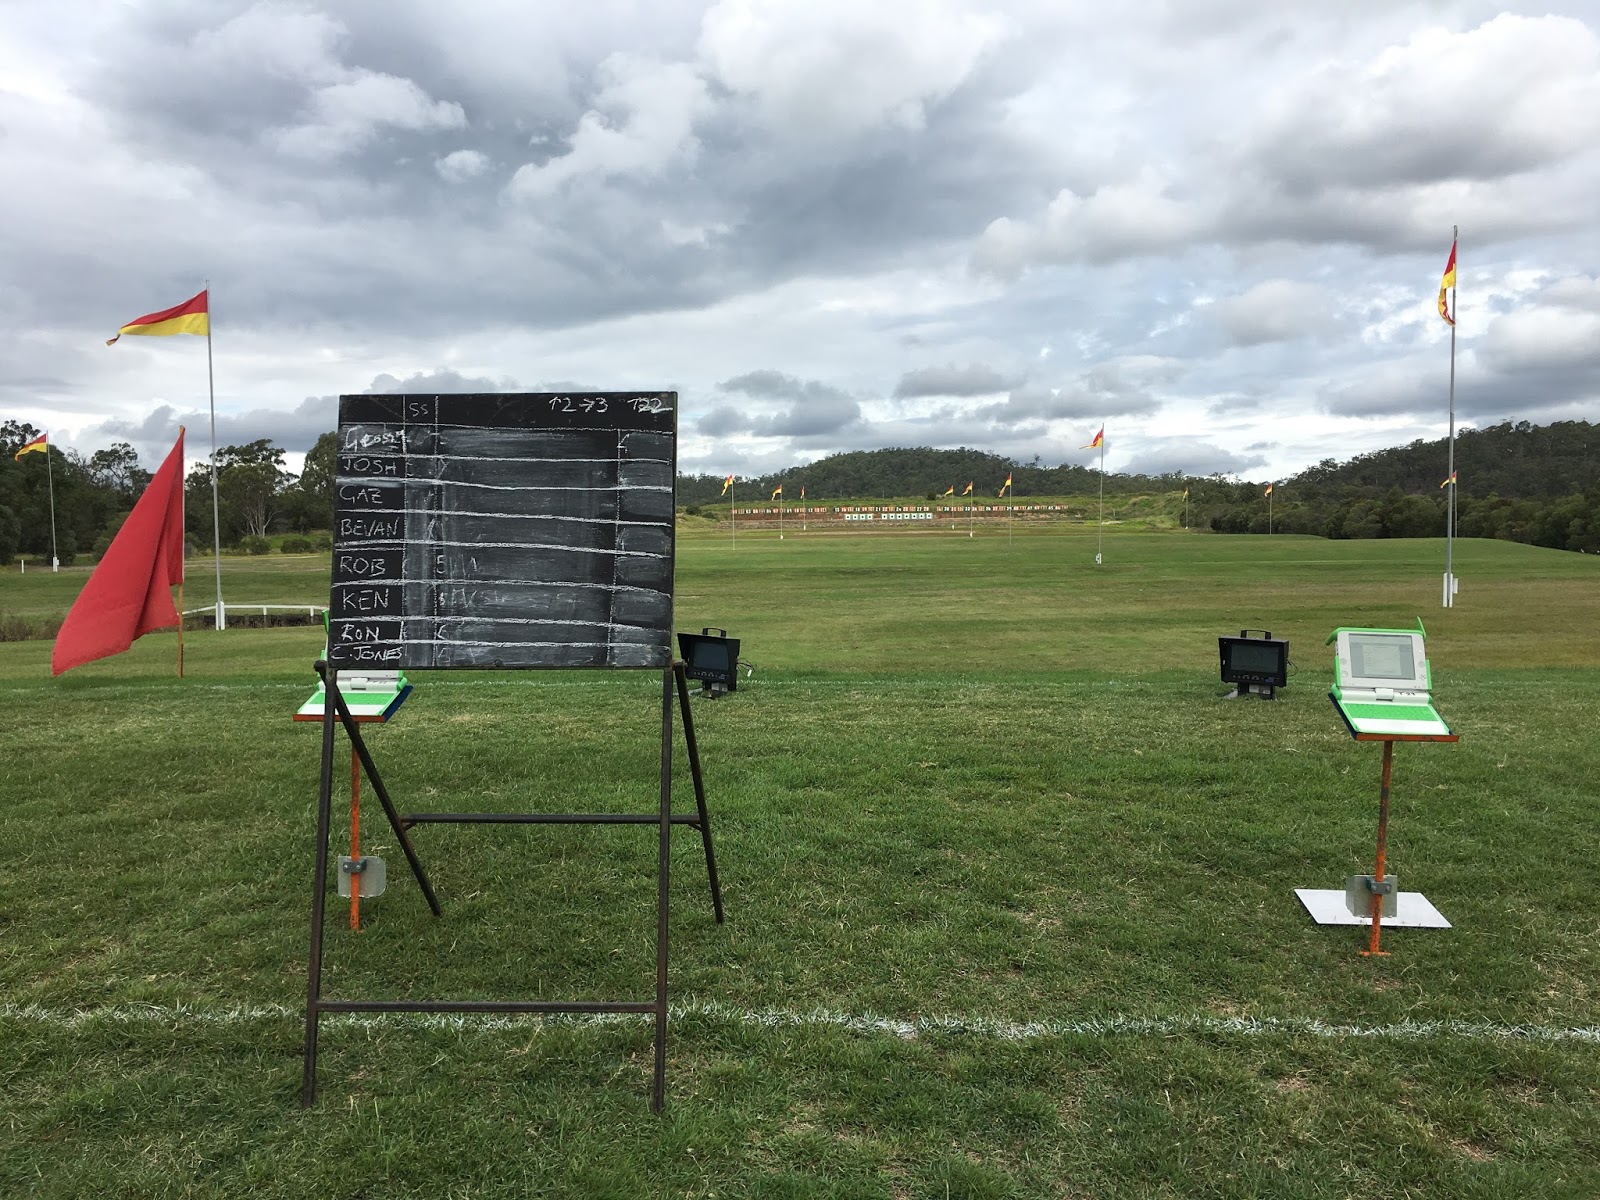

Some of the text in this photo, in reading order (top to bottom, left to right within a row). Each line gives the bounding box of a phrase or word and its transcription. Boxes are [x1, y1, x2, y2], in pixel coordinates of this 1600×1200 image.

[343, 457, 397, 475] JOSH
[339, 484, 383, 504] GAZ
[341, 517, 400, 537] BEVAN
[339, 556, 386, 577] ROB
[342, 588, 389, 611] KEN
[341, 623, 380, 641] RON
